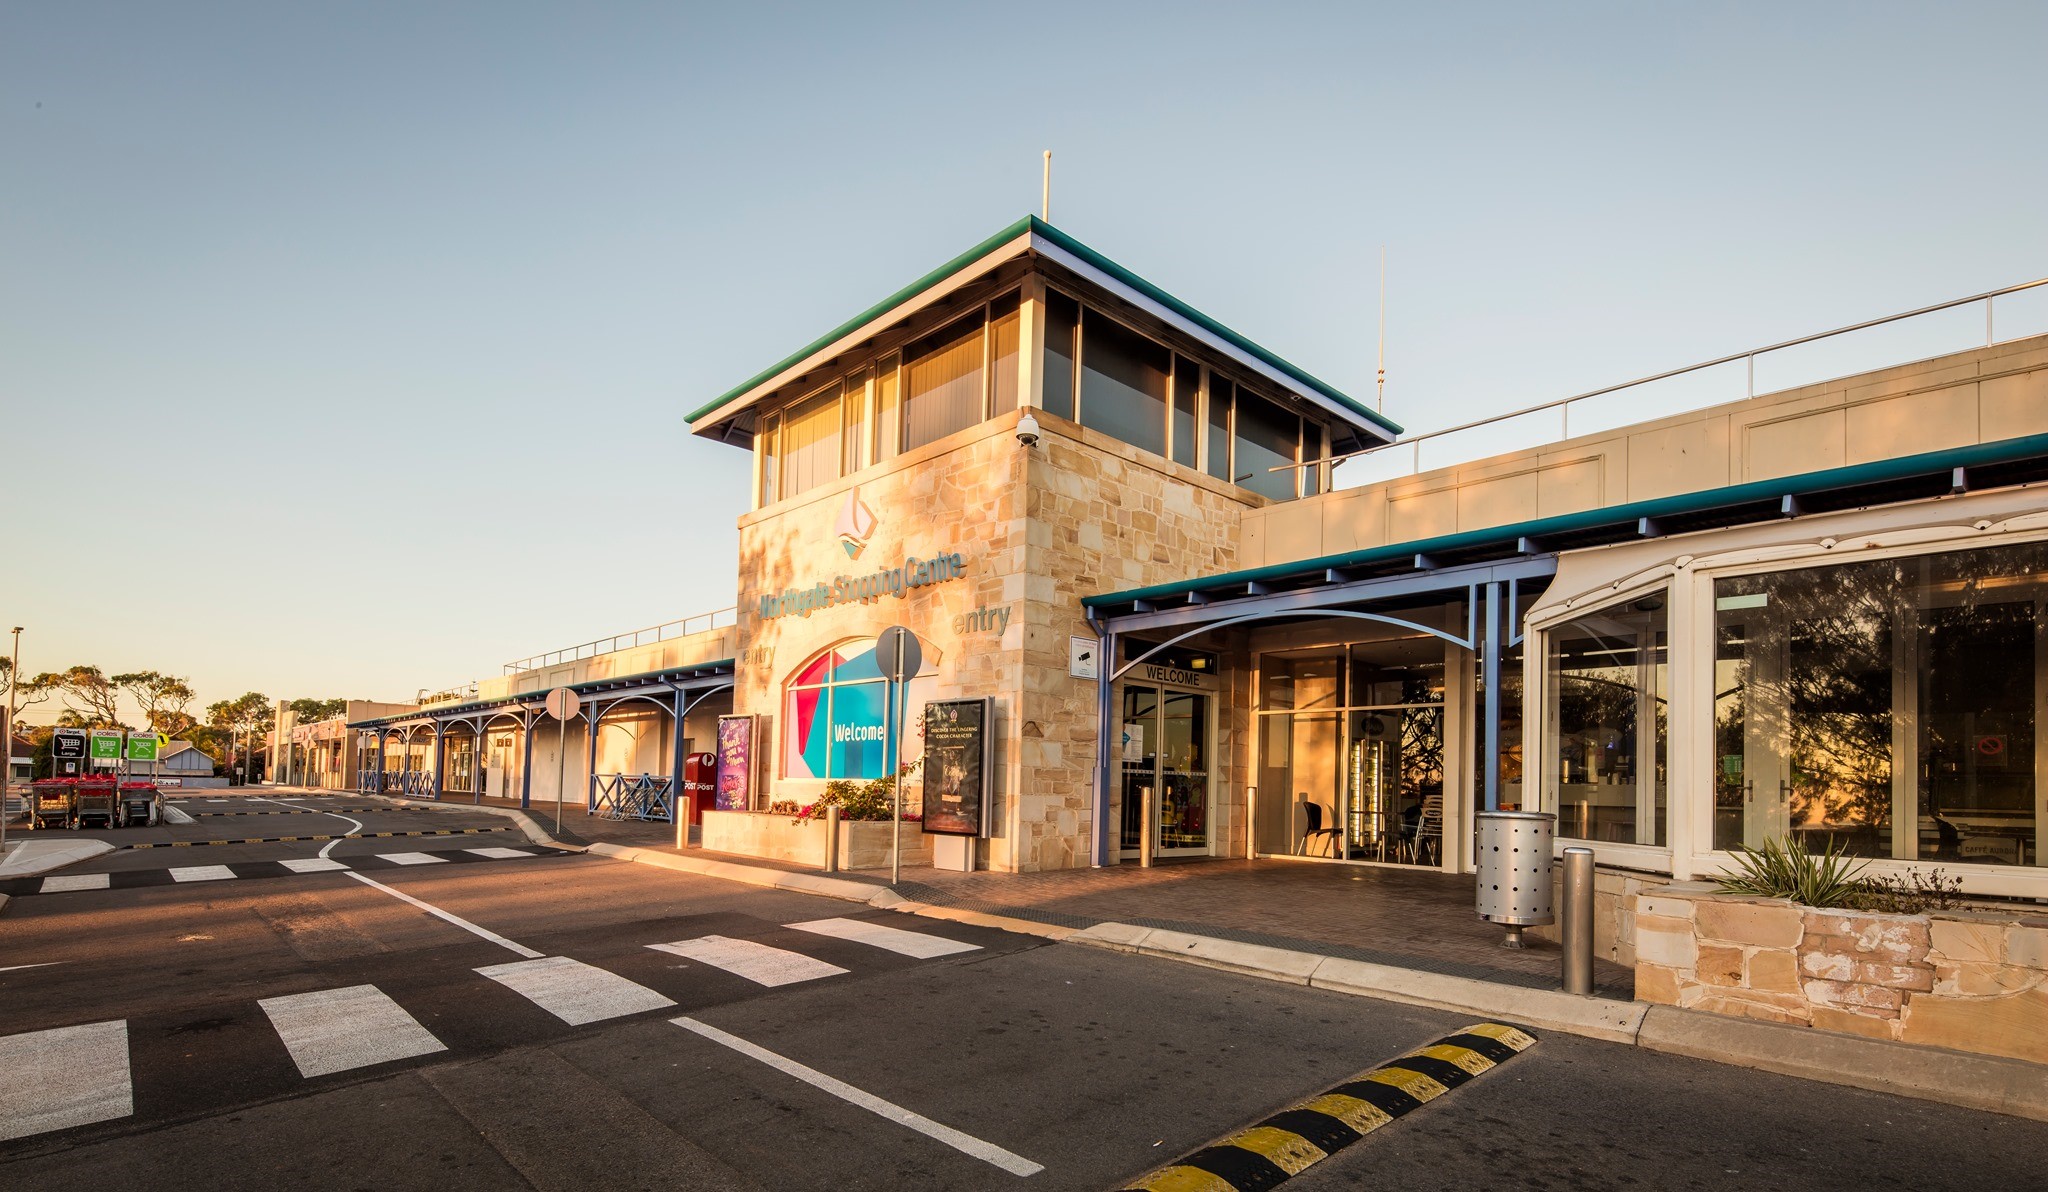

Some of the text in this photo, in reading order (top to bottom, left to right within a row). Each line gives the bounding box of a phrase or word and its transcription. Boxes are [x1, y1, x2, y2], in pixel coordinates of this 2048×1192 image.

[760, 551, 964, 618] Northgate Shopping Centre
[951, 604, 1012, 637] entry
[742, 644, 776, 669] entry
[1146, 666, 1200, 686] WELCOME
[834, 722, 885, 742] Welcome
[684, 782, 696, 790] POST
